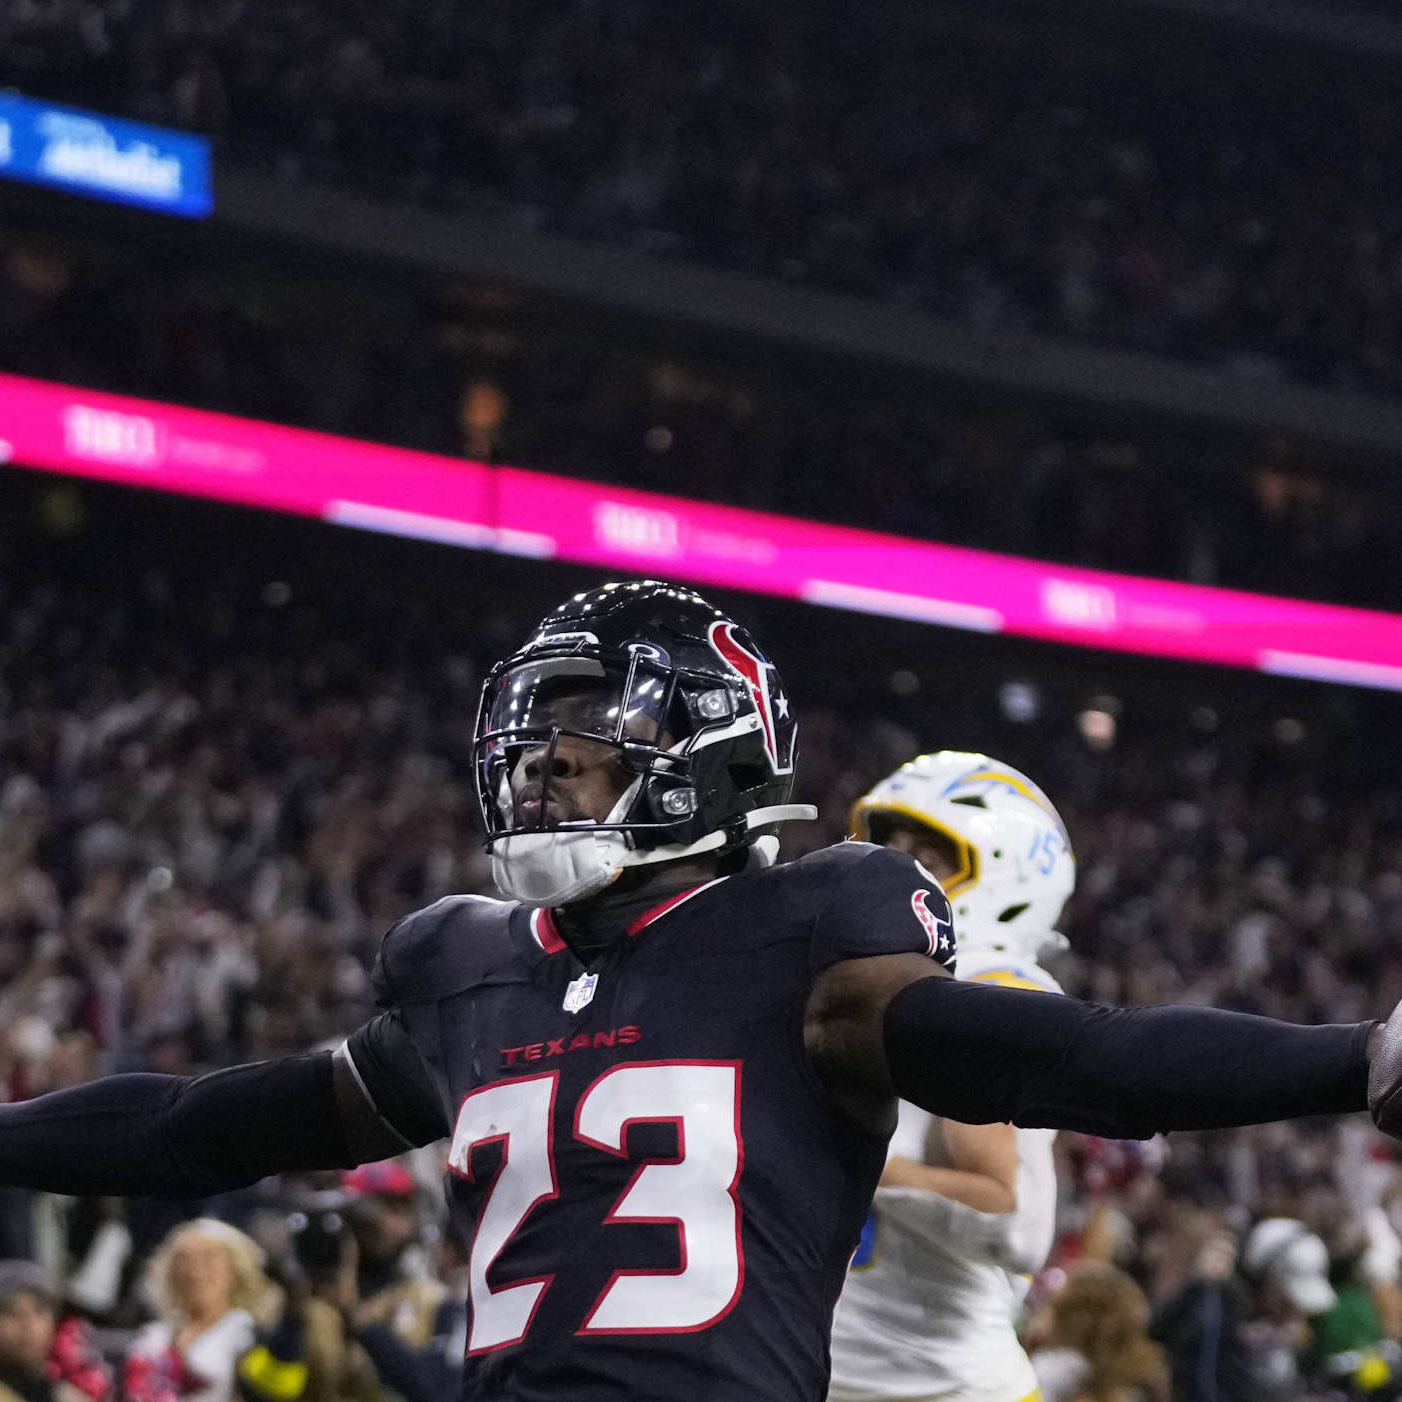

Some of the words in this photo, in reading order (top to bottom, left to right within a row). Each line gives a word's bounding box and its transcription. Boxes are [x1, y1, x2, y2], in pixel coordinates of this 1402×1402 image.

[1028, 830, 1059, 876] 15
[499, 1025, 643, 1065] TEXANS
[448, 1059, 745, 1358] 23
